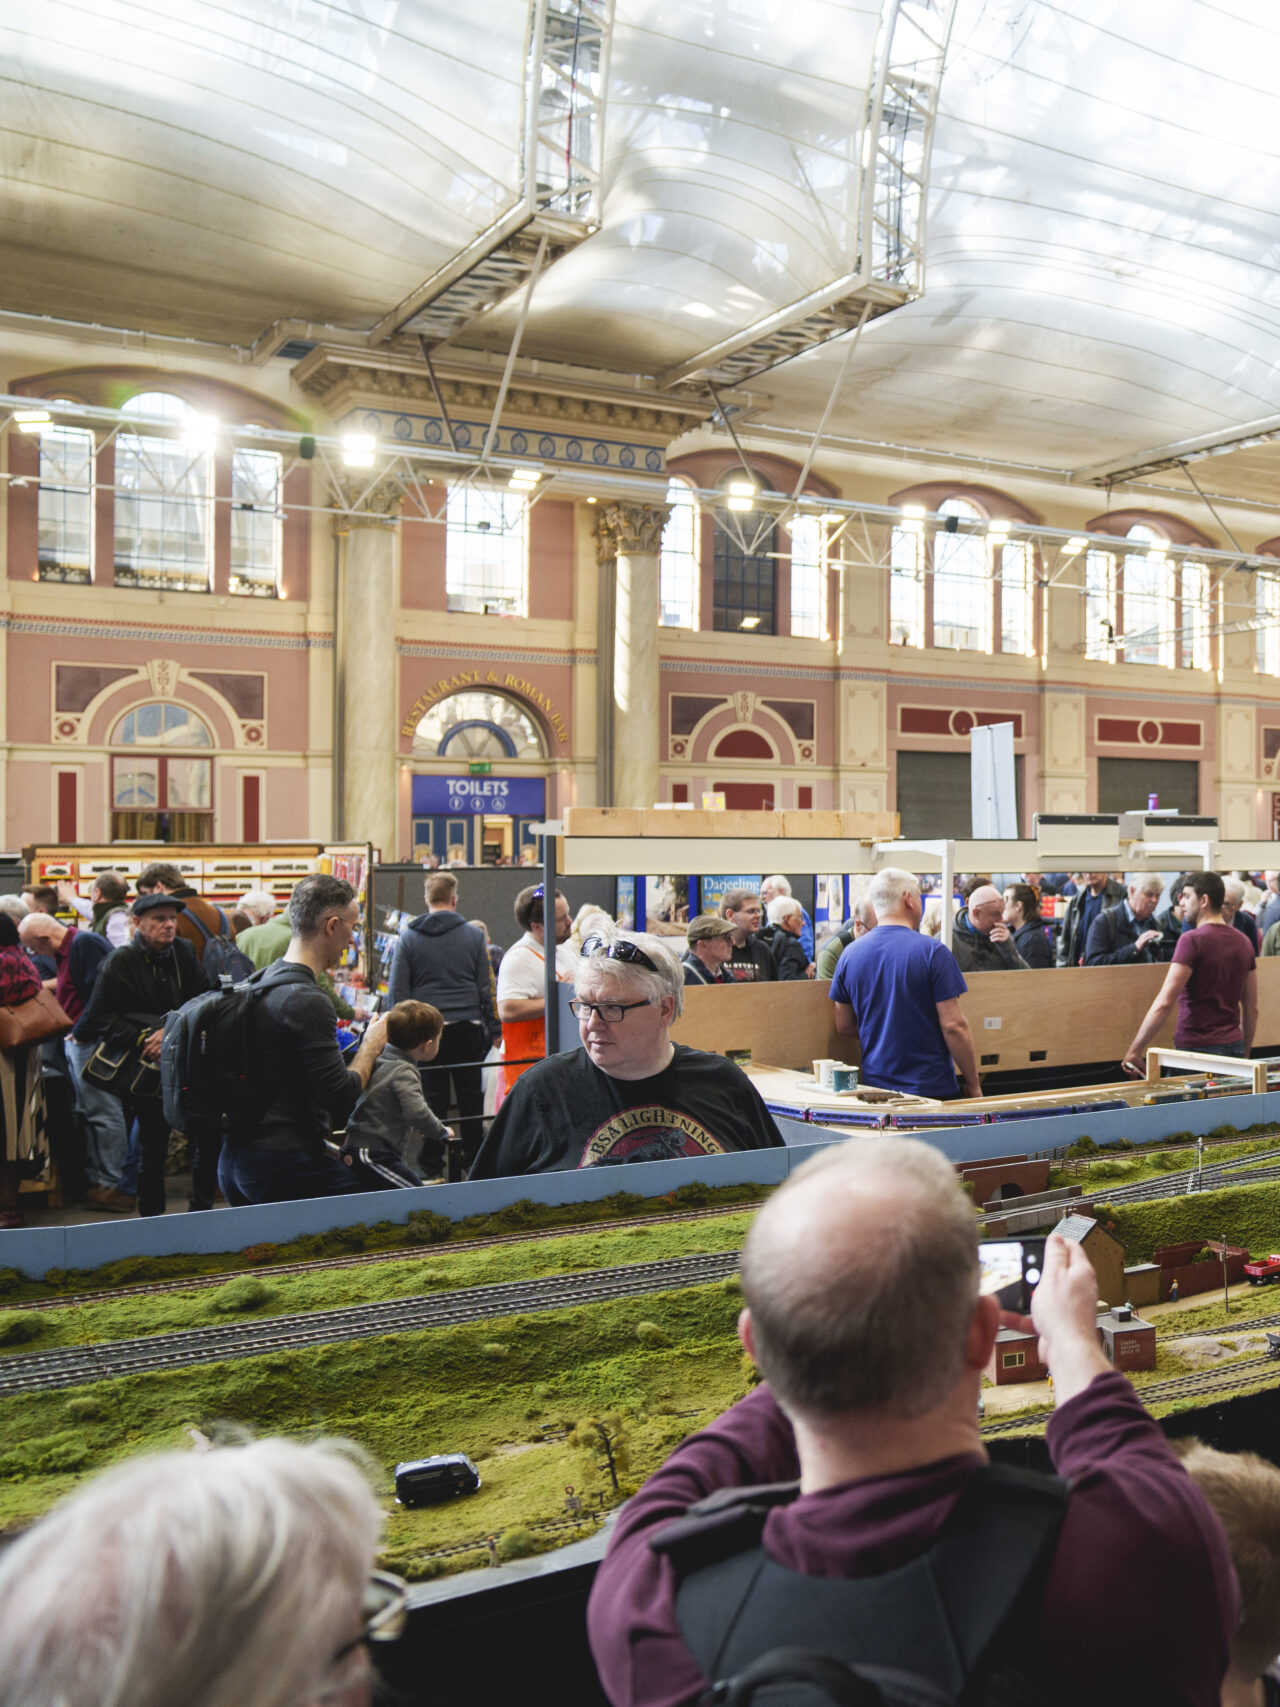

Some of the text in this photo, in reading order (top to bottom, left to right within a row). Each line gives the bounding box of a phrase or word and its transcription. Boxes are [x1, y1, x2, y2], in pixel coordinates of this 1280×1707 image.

[401, 669, 569, 743] RESTAURANT & ROMAN BAR
[446, 779, 509, 796] TOILETS
[703, 877, 760, 894] Darjeeling
[591, 1109, 719, 1155] BSA LIGHTNING
